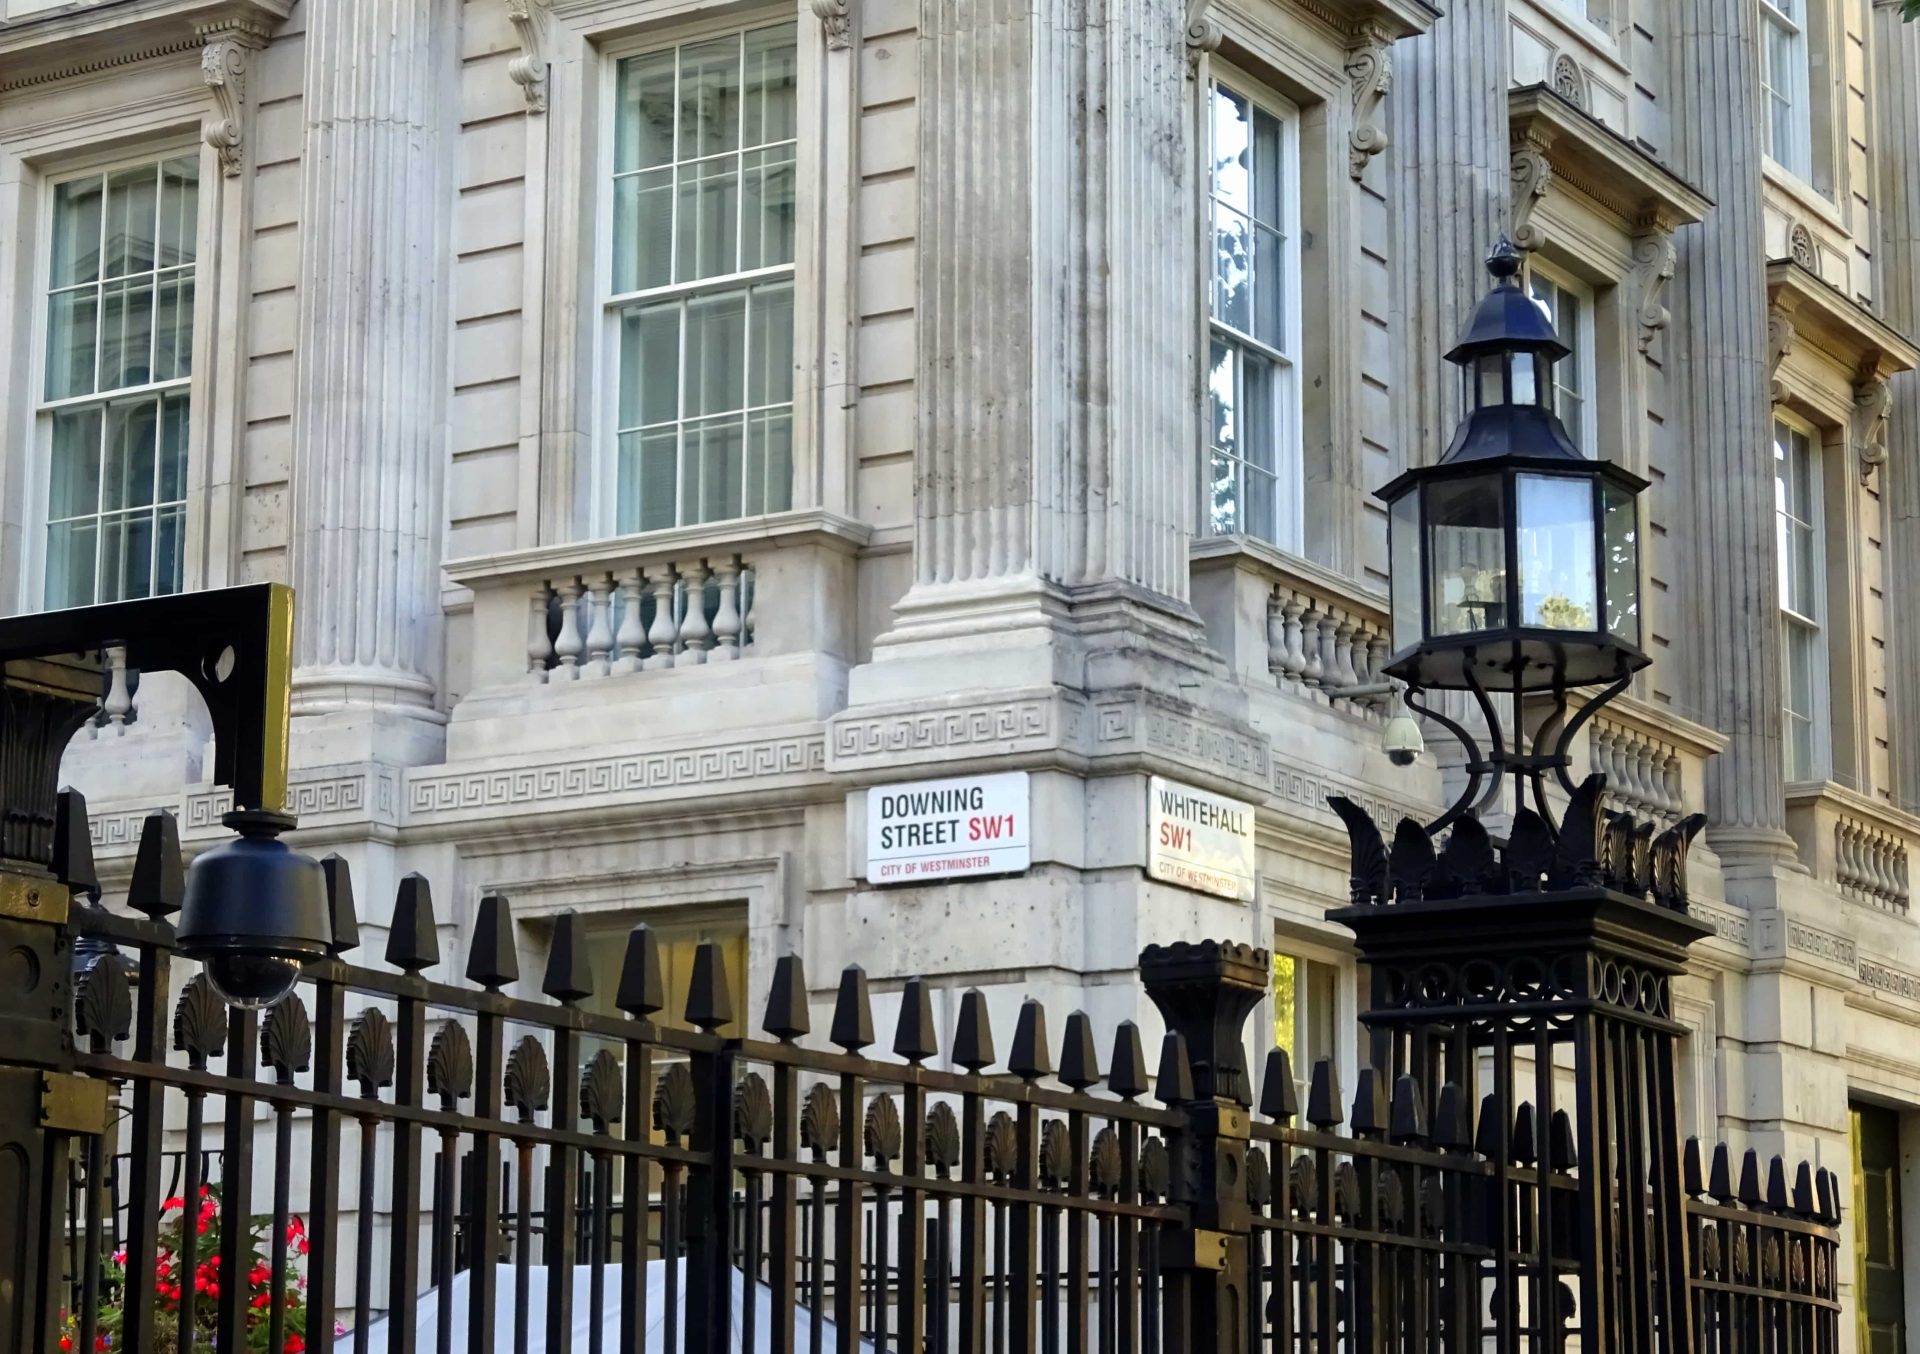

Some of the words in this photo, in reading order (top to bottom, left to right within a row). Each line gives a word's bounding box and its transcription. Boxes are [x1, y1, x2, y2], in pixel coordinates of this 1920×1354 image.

[882, 787, 983, 819] DOWNING
[1160, 790, 1247, 837] WHITEHALL
[881, 820, 960, 850] STREET
[969, 815, 1014, 841] SW1
[1160, 822, 1192, 852] SW1
[881, 864, 902, 876] CITY
[905, 862, 917, 874] OF
[921, 856, 990, 872] WESTMINSTER
[1159, 861, 1175, 875] CITY
[1176, 866, 1186, 878] OF
[1188, 870, 1237, 891] WESTMINSTER
